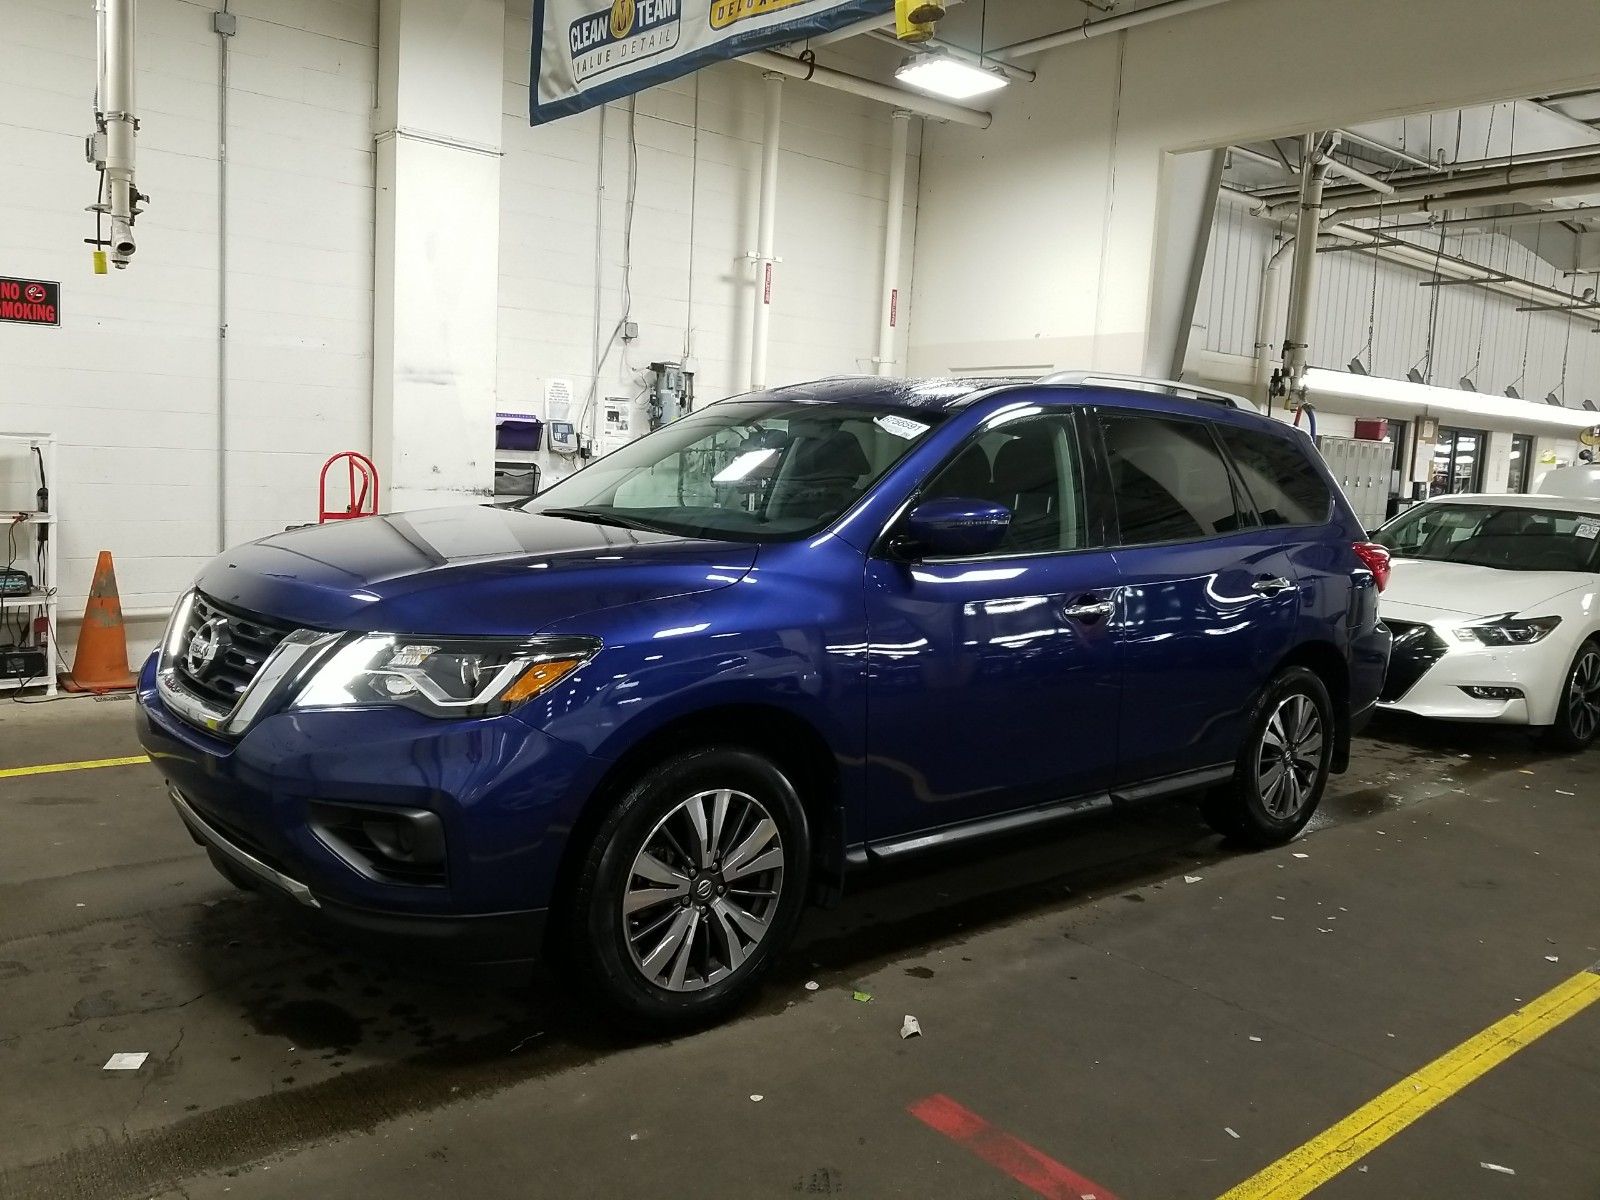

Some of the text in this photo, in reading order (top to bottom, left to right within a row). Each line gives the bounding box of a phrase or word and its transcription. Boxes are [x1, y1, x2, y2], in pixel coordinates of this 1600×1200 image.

[717, 0, 779, 20] DELU
[570, 15, 608, 52] CLEAN
[637, 0, 677, 27] TEAM
[621, 29, 670, 57] DETAIL
[1, 282, 20, 300] NO
[0, 301, 55, 322] MOKING
